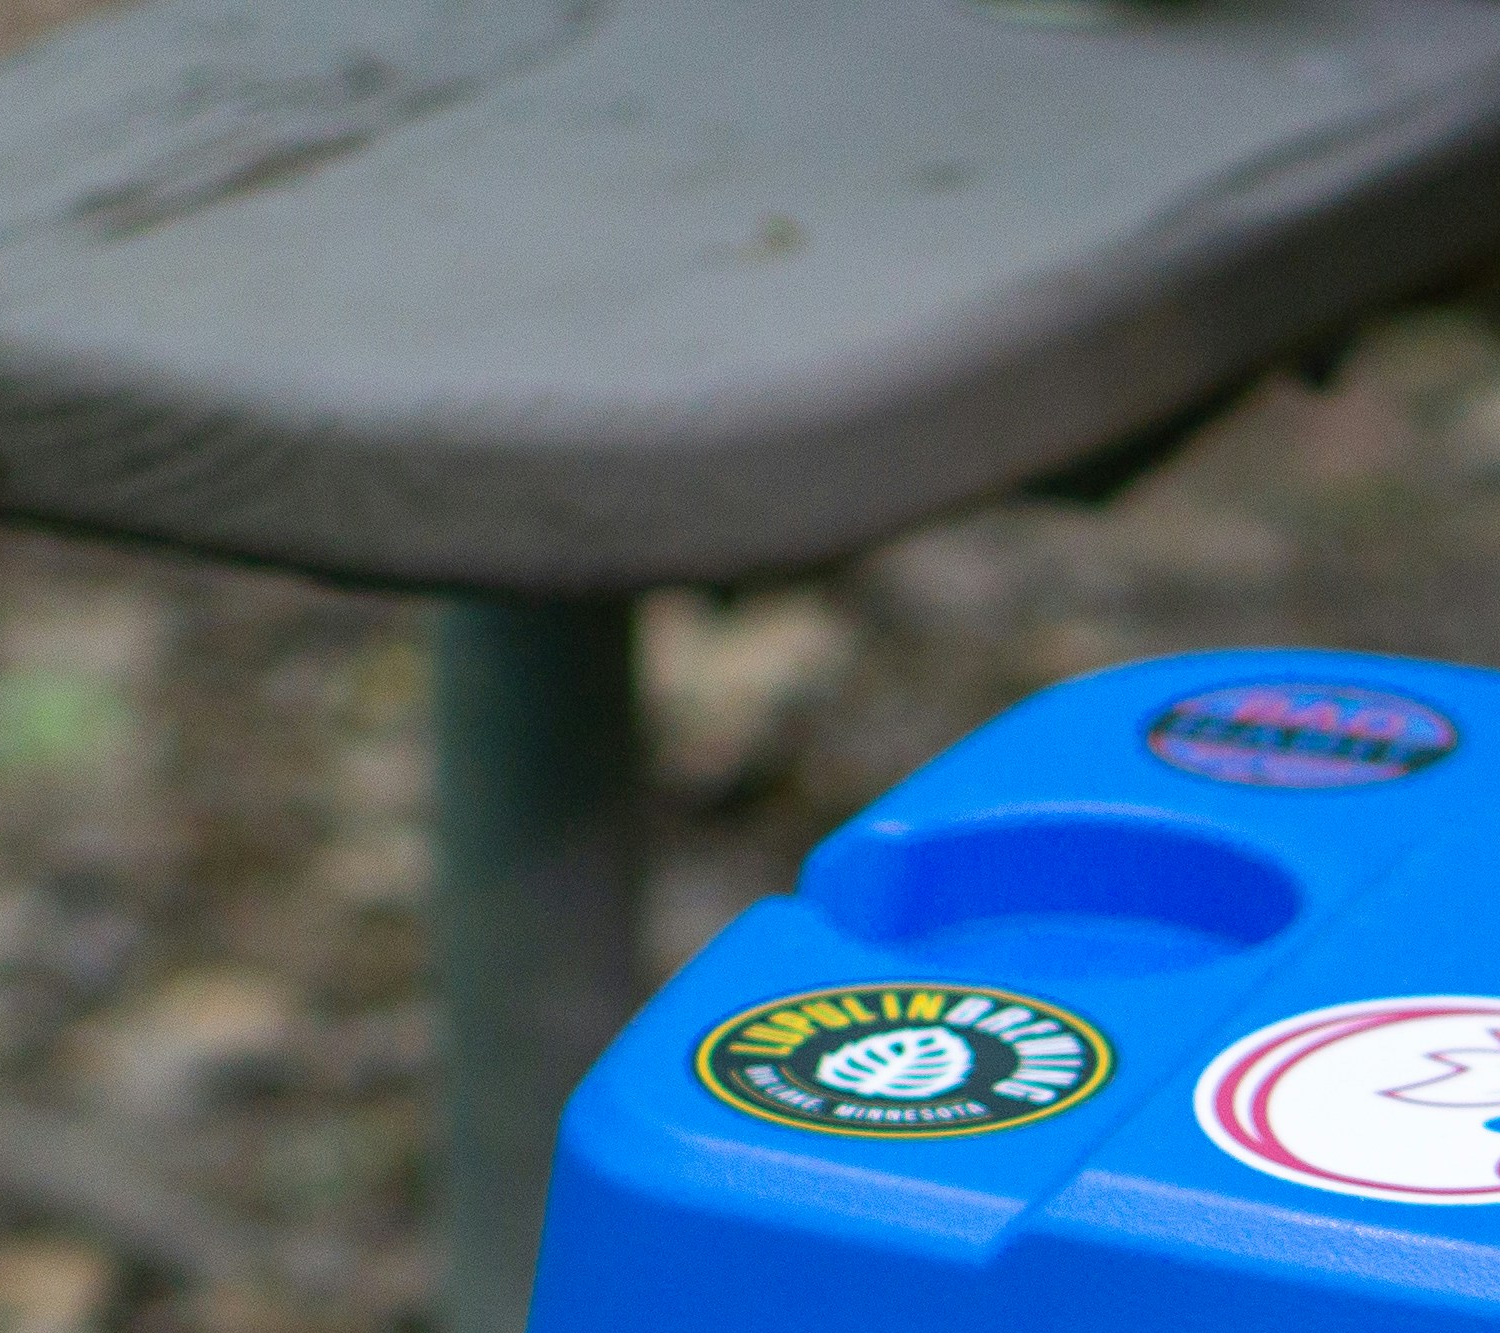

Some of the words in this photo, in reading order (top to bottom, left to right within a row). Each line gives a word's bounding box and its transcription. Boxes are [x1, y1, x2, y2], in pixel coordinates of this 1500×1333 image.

[728, 993, 946, 1056] LUPULIN
[945, 996, 1083, 1102] BREWING
[833, 1099, 988, 1122] MINNESOTA
